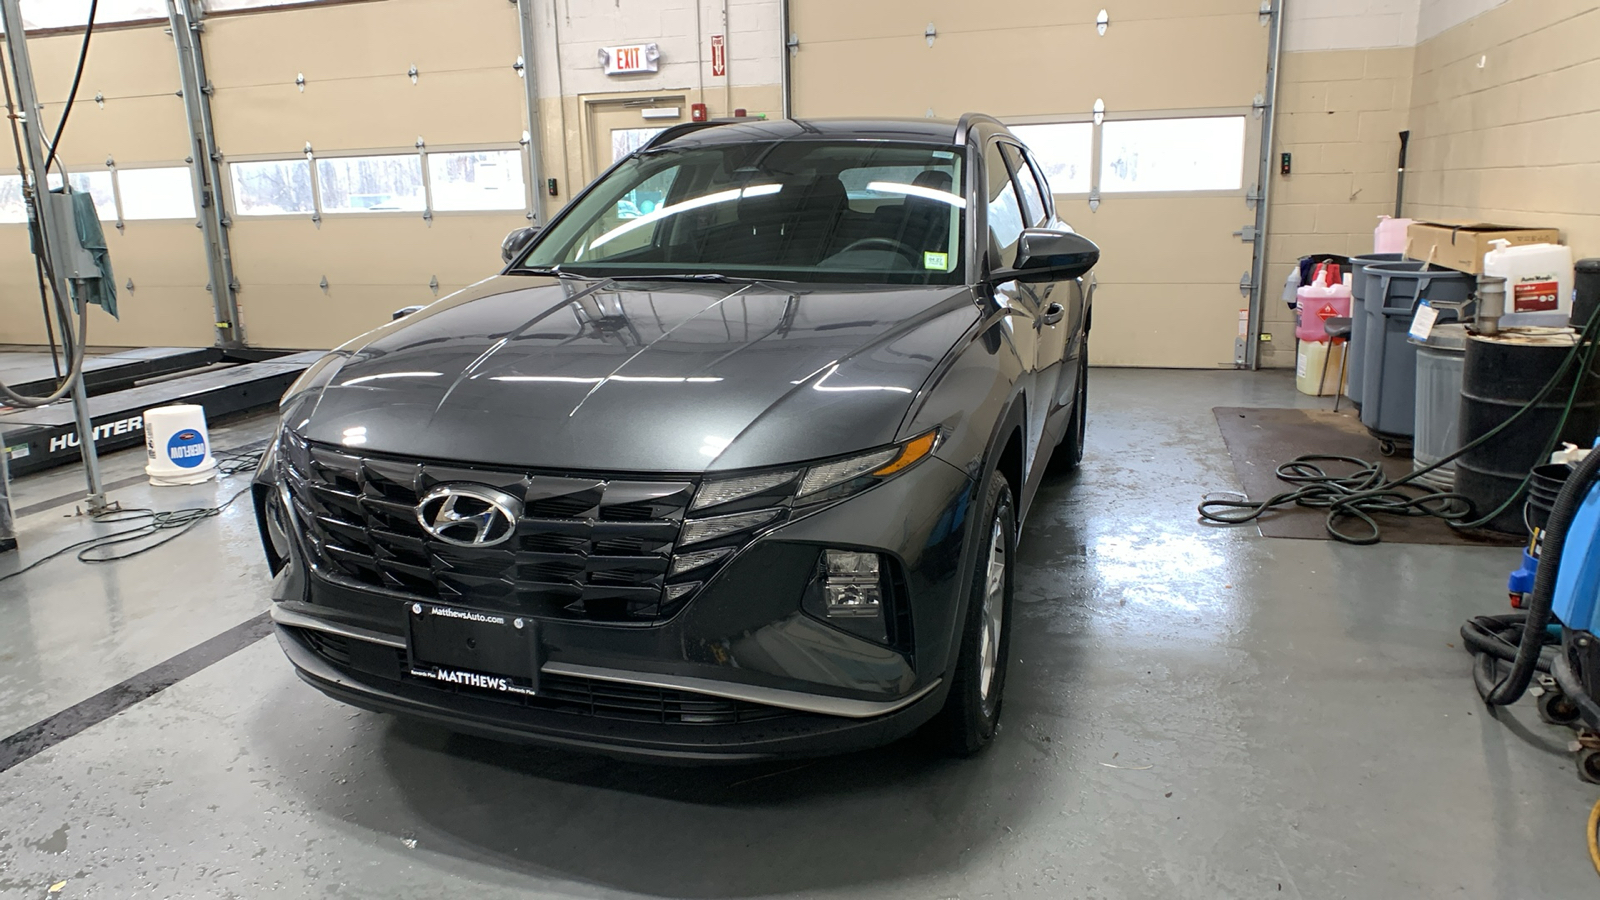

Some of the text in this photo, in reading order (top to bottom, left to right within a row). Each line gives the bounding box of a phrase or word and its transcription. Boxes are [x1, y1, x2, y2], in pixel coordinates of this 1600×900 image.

[617, 48, 640, 69] EXIT
[431, 607, 505, 624] MatthewsAuto.com
[437, 669, 507, 691] MATTHEWS
